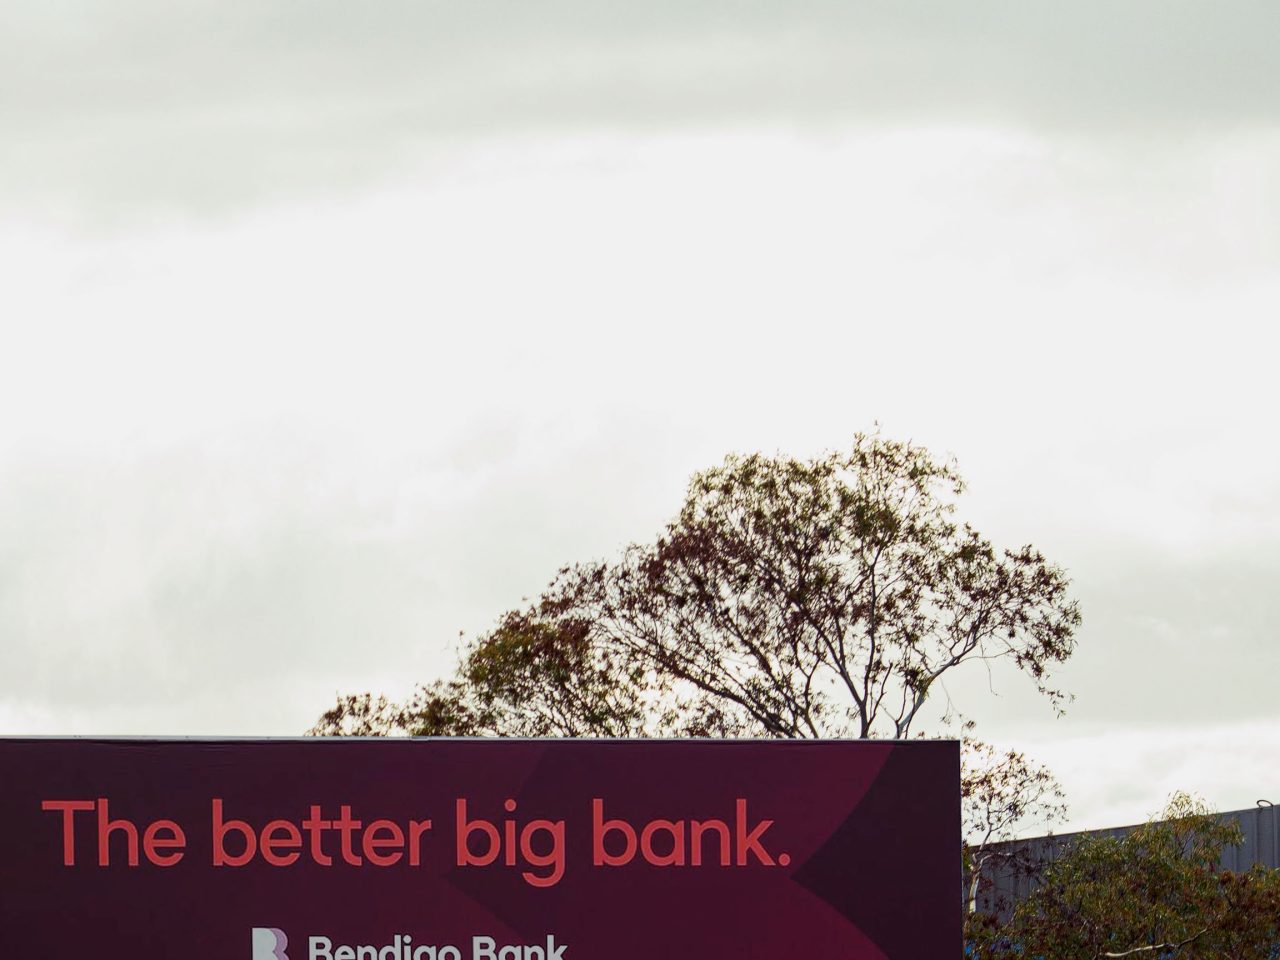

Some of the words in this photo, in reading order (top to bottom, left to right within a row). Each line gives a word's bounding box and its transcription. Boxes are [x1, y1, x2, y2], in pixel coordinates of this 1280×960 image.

[41, 798, 186, 867] The
[212, 798, 432, 867] better
[456, 798, 566, 888] big
[592, 798, 791, 867] bank.
